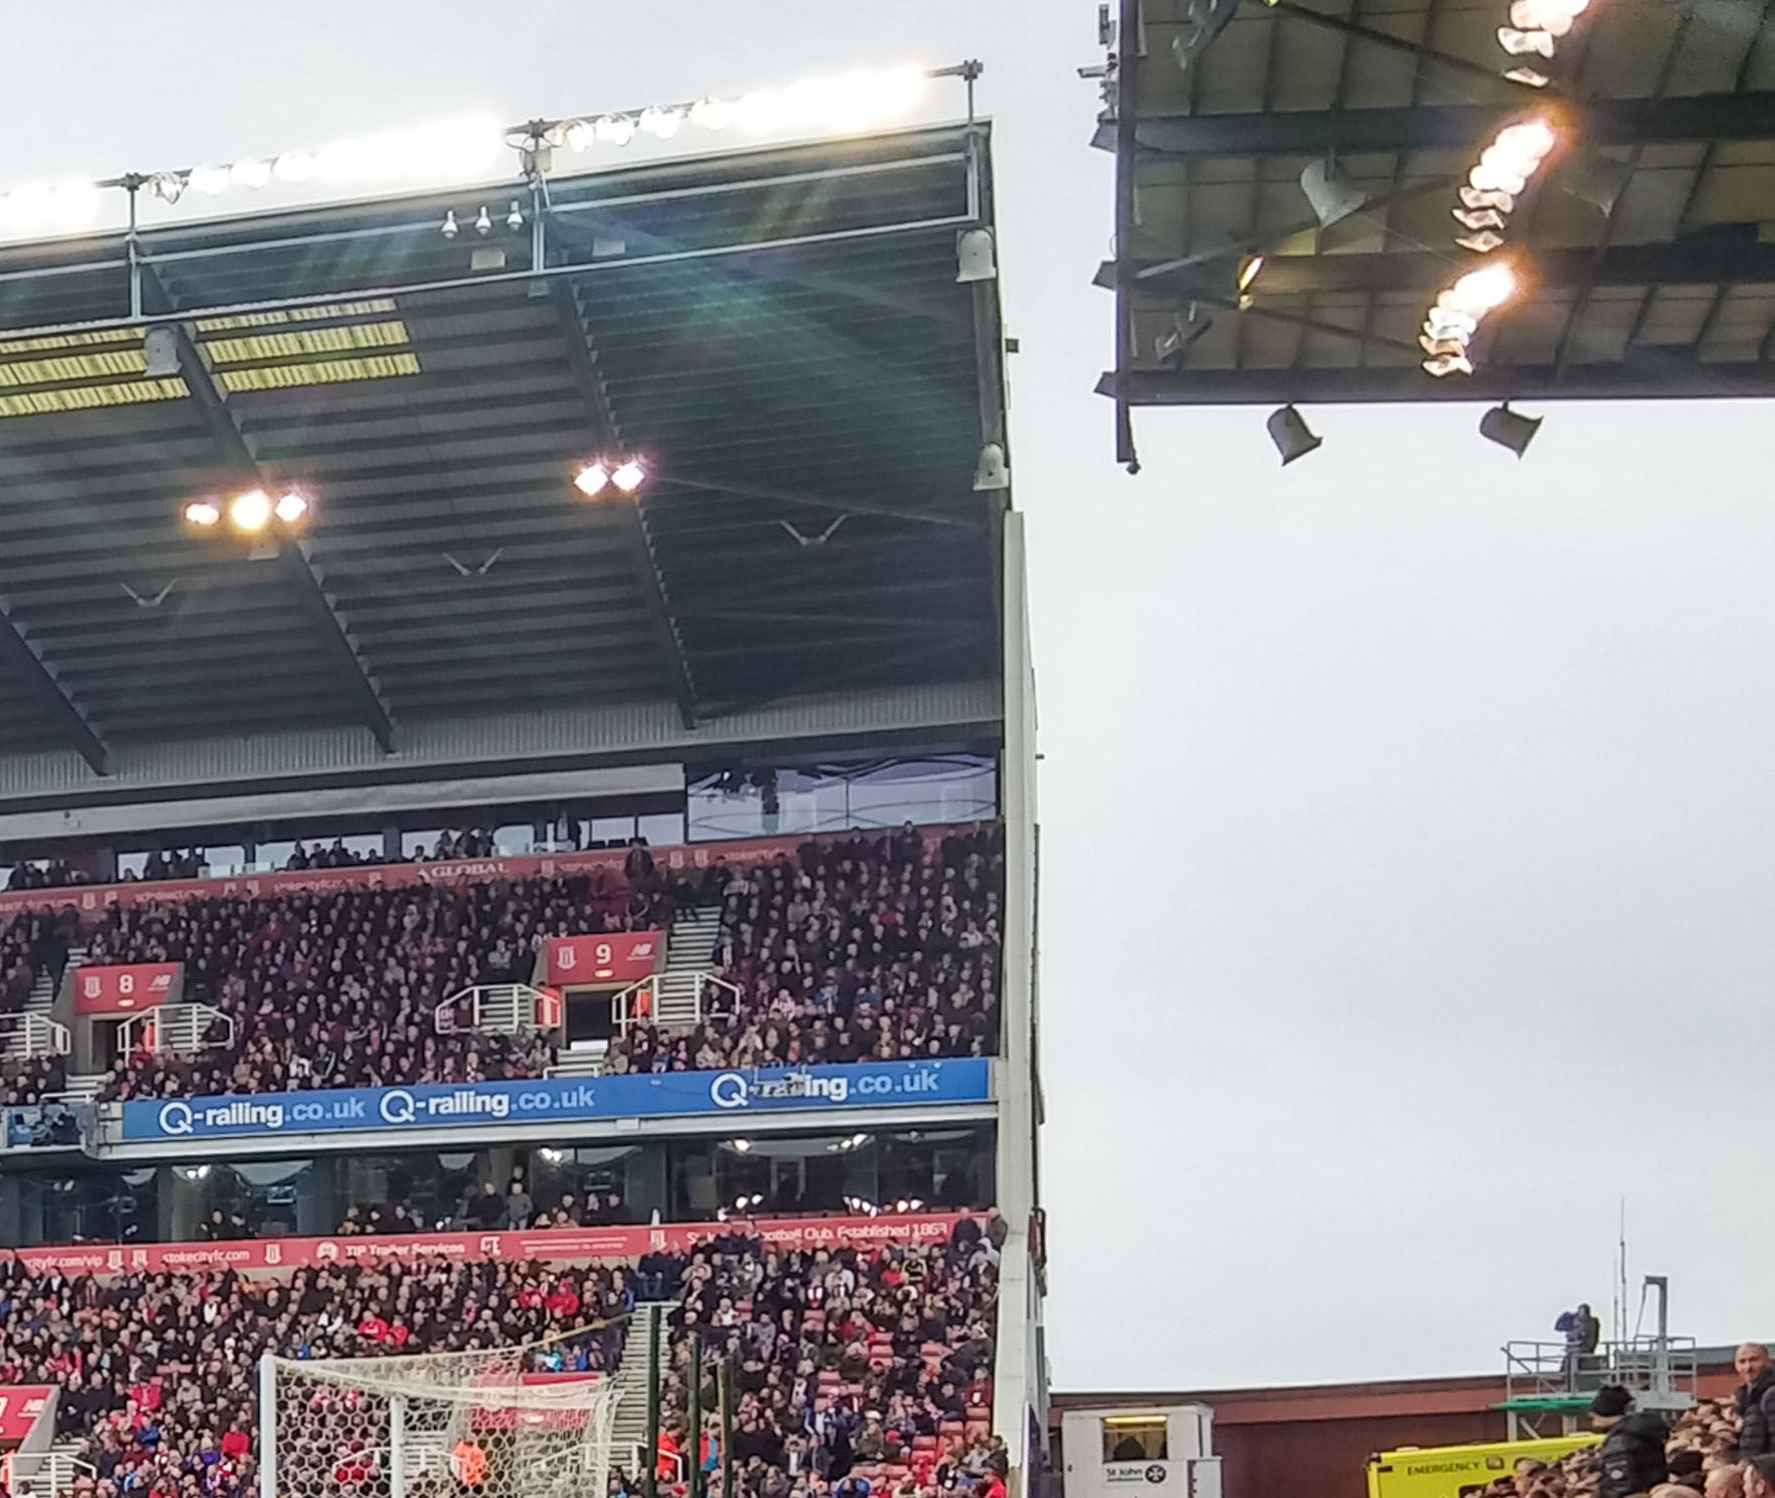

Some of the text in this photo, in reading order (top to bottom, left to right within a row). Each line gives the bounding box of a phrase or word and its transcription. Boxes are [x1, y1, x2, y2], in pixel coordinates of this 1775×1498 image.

[596, 943, 611, 964] 9
[119, 974, 134, 993] 8
[380, 1085, 594, 1124] Q-railing.co.uk
[158, 1098, 365, 1136] Q-railing.co.uk
[758, 1227, 802, 1242] ootball
[346, 1244, 367, 1257] TIP
[24, 1253, 103, 1271] cityfc.com/vip
[1407, 1461, 1481, 1476] EMERGENCY
